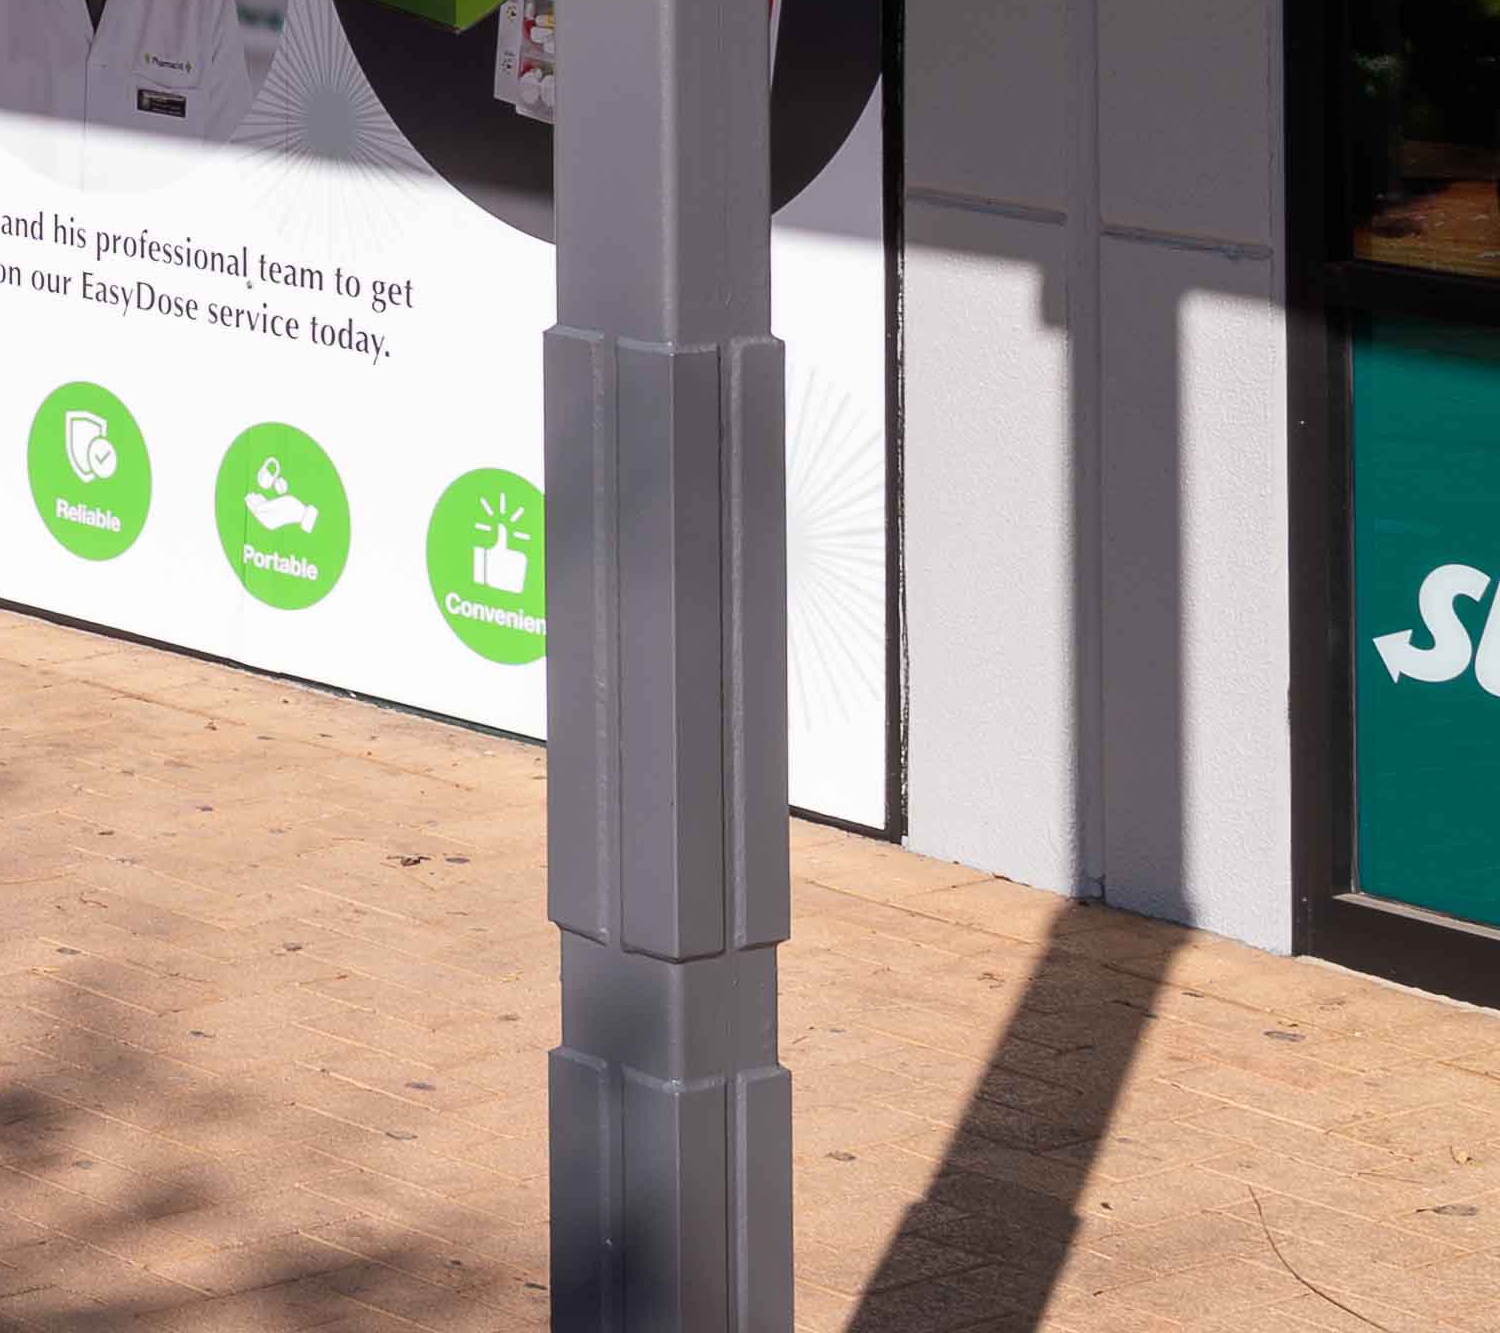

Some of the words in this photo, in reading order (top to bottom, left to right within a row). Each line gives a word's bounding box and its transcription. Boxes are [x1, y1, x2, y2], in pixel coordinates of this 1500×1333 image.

[1, 208, 44, 242] and
[53, 214, 87, 251] his
[96, 225, 249, 278] professional
[259, 255, 324, 292] team
[334, 266, 362, 297] to
[371, 276, 415, 315] get
[31, 266, 72, 297] our
[81, 272, 199, 322] EasyDose
[207, 300, 300, 341] service
[310, 315, 391, 366] today.
[55, 497, 122, 533] Reliable
[242, 542, 319, 581] Portable
[445, 591, 546, 636] Convenien
